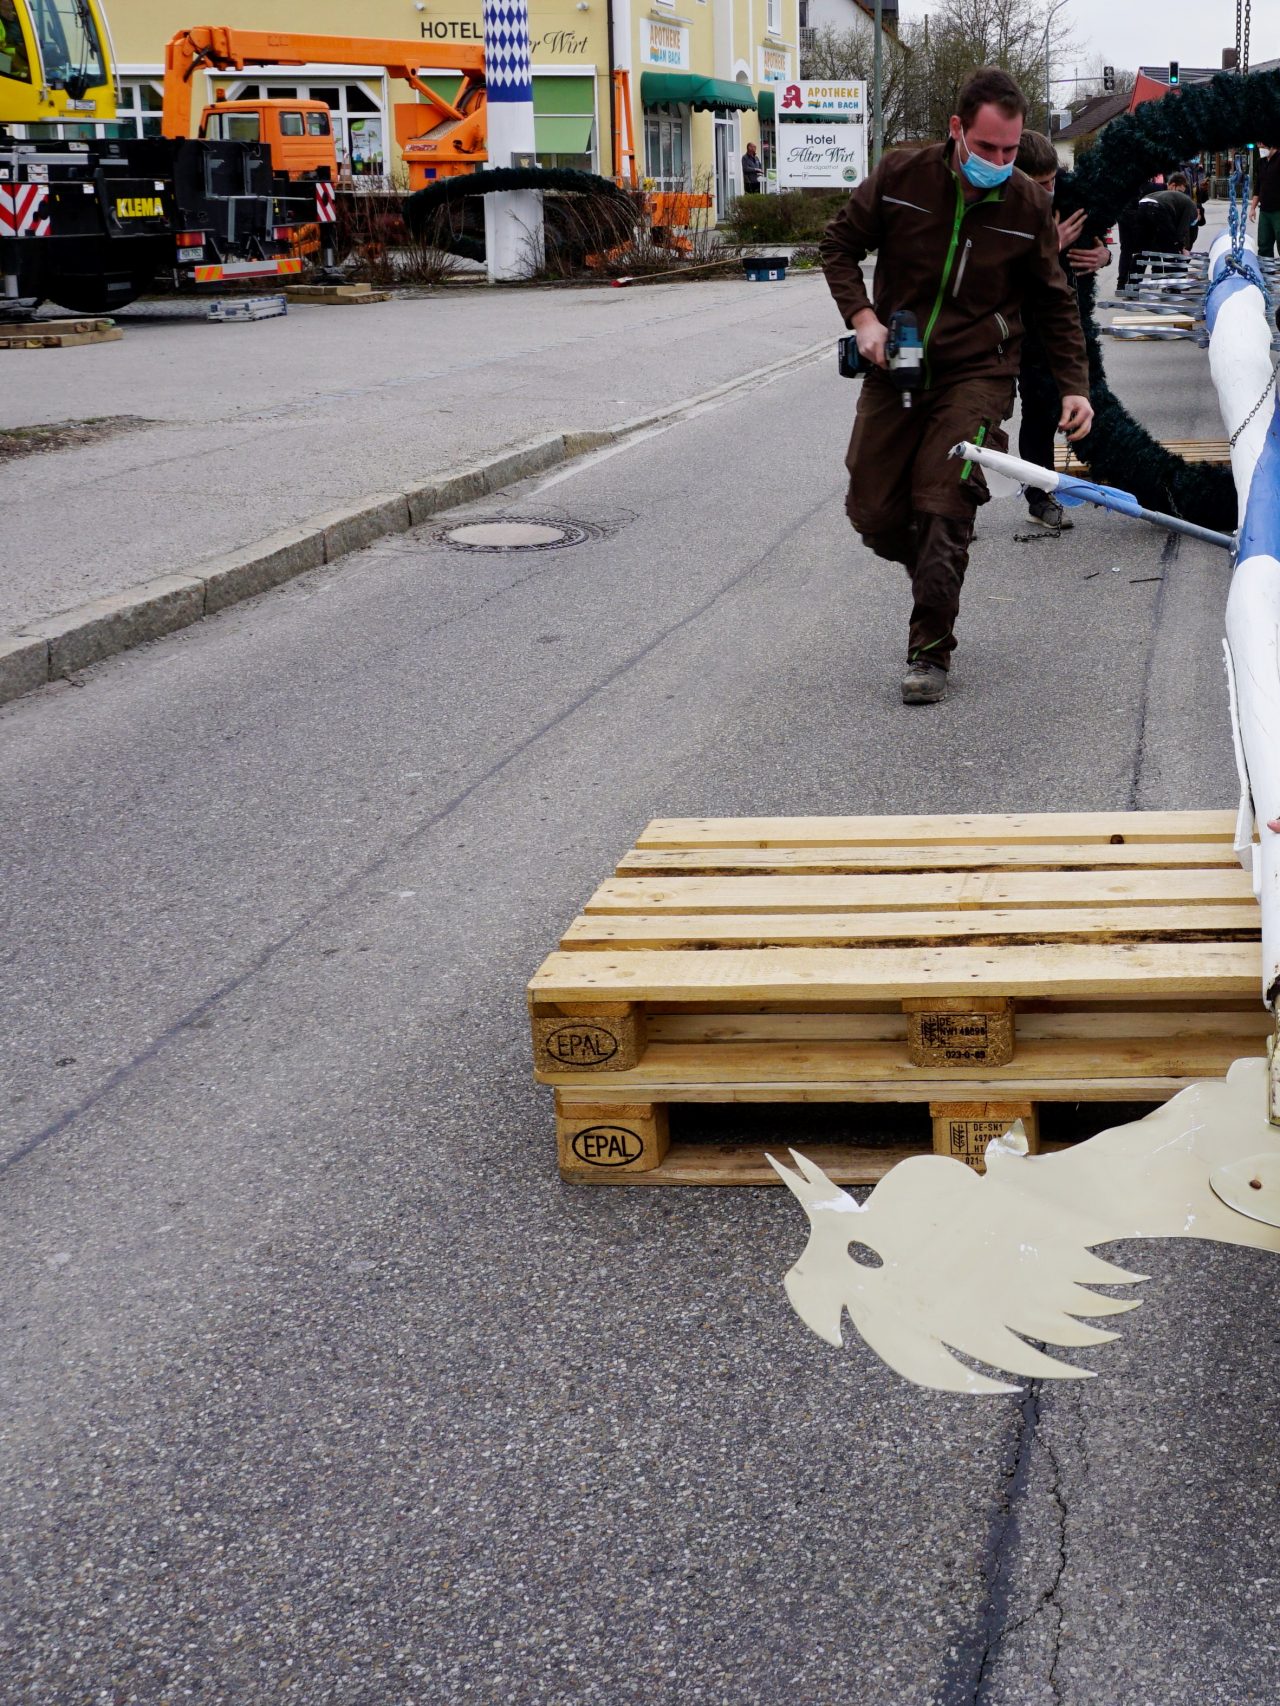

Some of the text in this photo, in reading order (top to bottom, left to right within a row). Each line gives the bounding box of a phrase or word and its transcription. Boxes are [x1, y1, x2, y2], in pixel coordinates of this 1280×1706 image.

[421, 22, 483, 38] HOTEL
[650, 24, 681, 50] APOTHEKE
[543, 30, 588, 54] Wirt
[659, 49, 681, 65] AM BACH
[807, 87, 859, 98] APOTHEKE
[822, 101, 859, 109] AM BACH
[806, 134, 836, 145] Hotel
[787, 146, 855, 163] Alter Wirt
[116, 197, 164, 218] KLEMA
[557, 1034, 608, 1057] EPAL
[583, 1135, 635, 1158] EPAL
